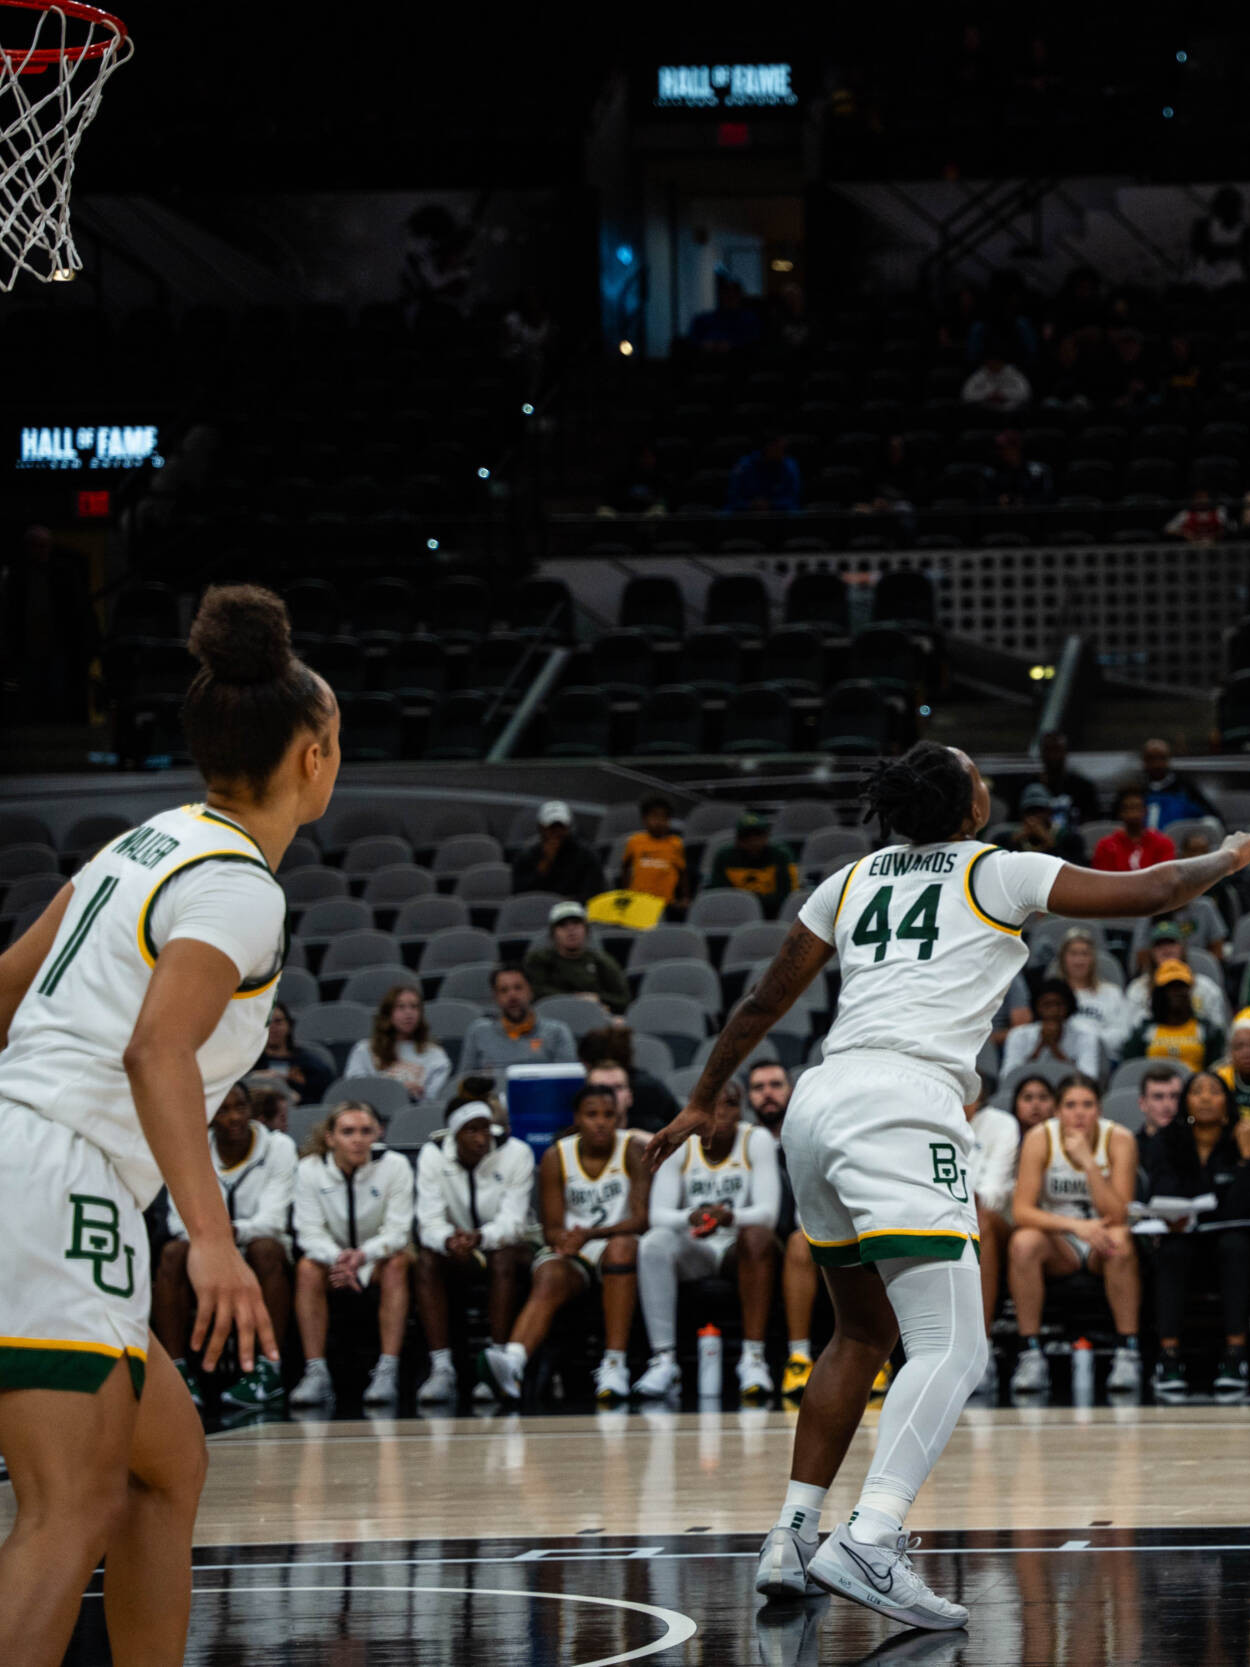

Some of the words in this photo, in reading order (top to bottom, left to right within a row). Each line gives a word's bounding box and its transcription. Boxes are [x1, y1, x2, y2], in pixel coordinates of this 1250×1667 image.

[657, 64, 716, 98] HALL
[730, 62, 793, 97] FAME
[21, 426, 78, 461] HALL
[76, 426, 96, 450] OF
[96, 425, 158, 459] FAME
[869, 852, 957, 877] EDWARDS
[851, 883, 943, 963] 44
[929, 1143, 968, 1203] BU
[65, 1193, 135, 1299] BU
